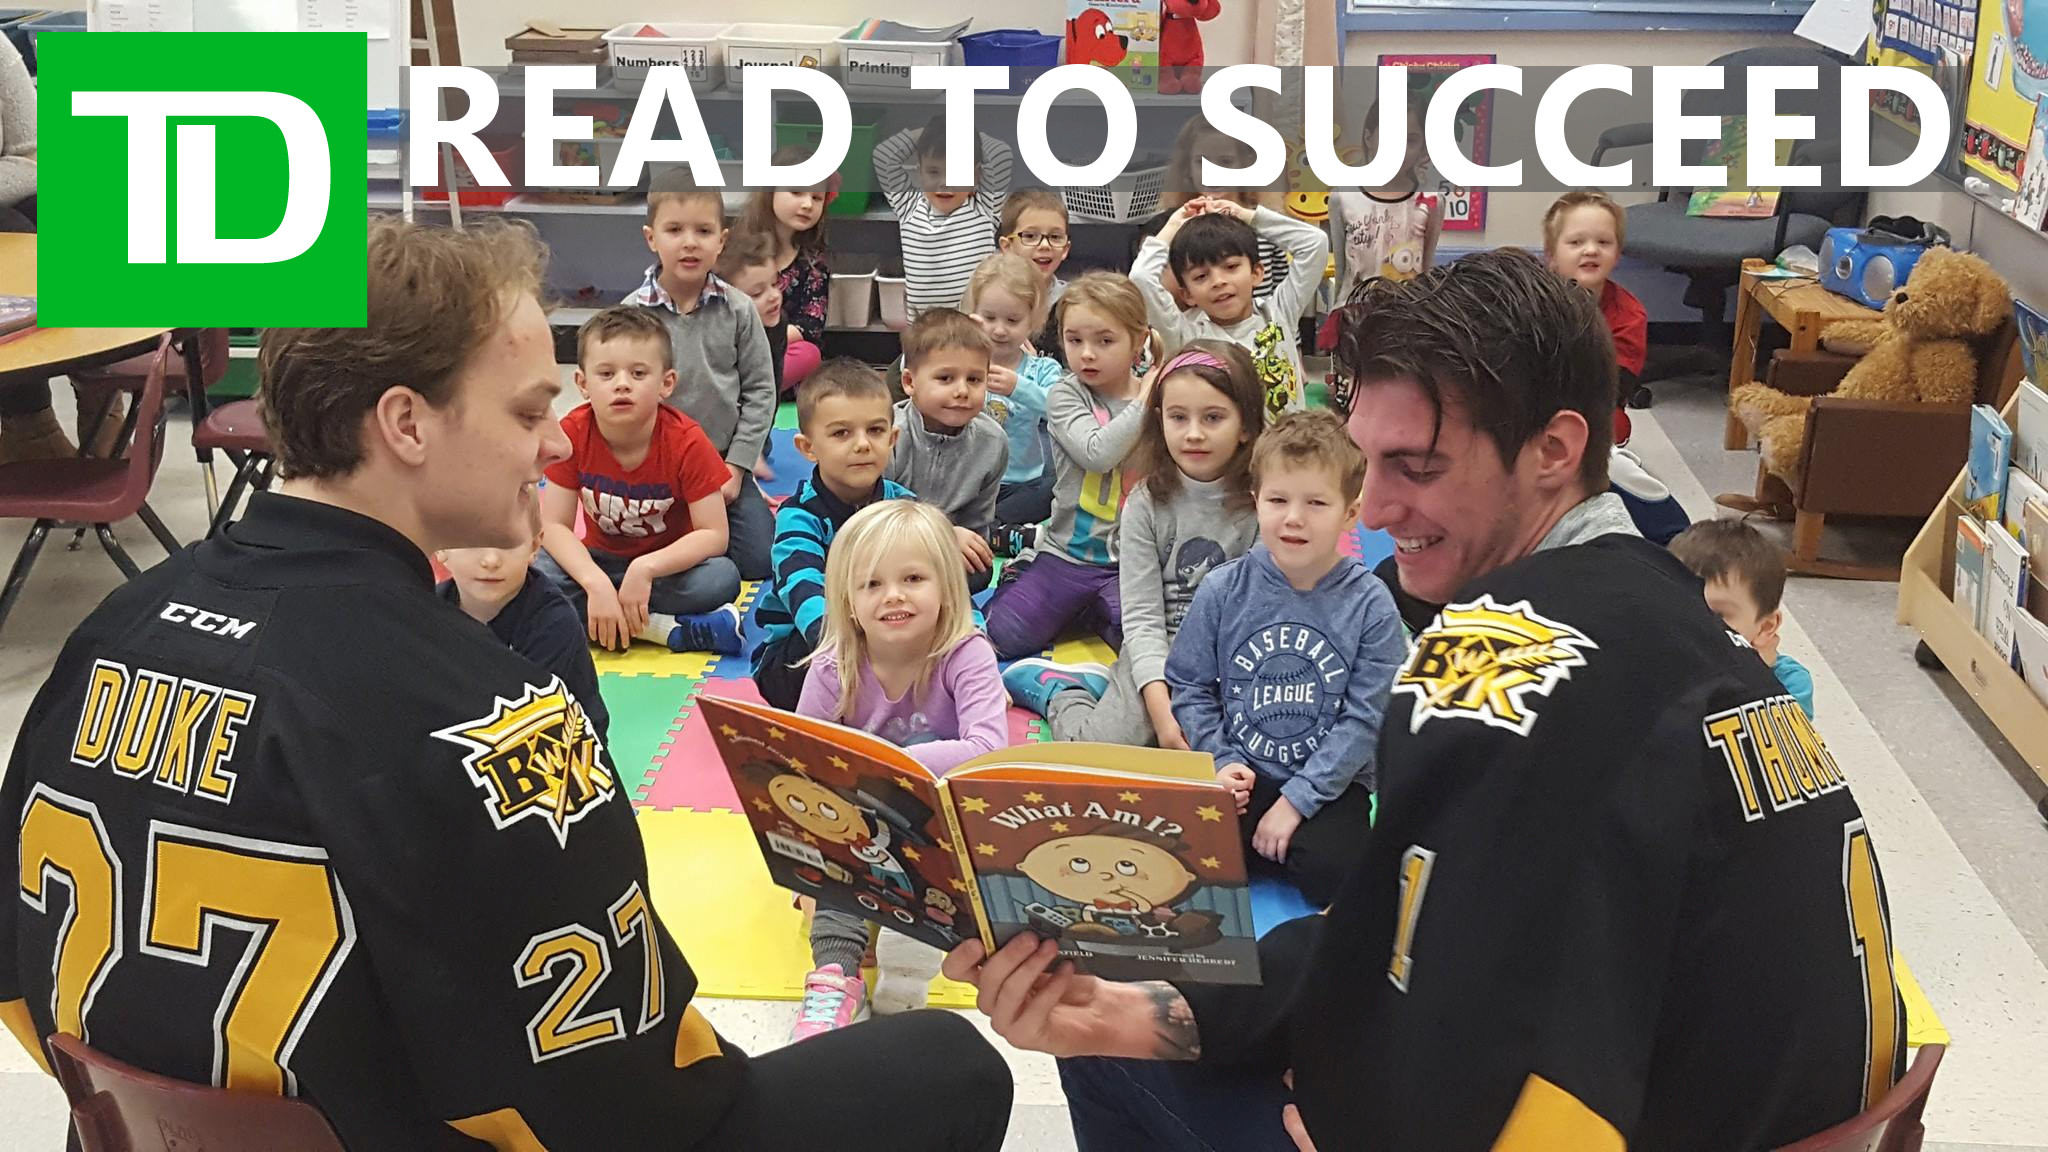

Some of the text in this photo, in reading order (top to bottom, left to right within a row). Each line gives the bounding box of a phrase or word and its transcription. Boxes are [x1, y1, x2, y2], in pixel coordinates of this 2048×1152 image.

[616, 57, 679, 67] Numbers
[849, 60, 910, 78] Printing
[1449, 200, 1468, 218] 10
[160, 601, 257, 639] CCM
[1234, 626, 1346, 684] BASEBALL
[1252, 682, 1317, 711] LEAGUE
[70, 658, 257, 805] DUKE
[1232, 712, 1330, 764] SLUGGERS
[989, 801, 1184, 837] What Am I?
[19, 781, 357, 1097] 27
[1386, 844, 1437, 993] 1
[513, 880, 665, 1064] 27
[1842, 817, 1897, 1112] 1
